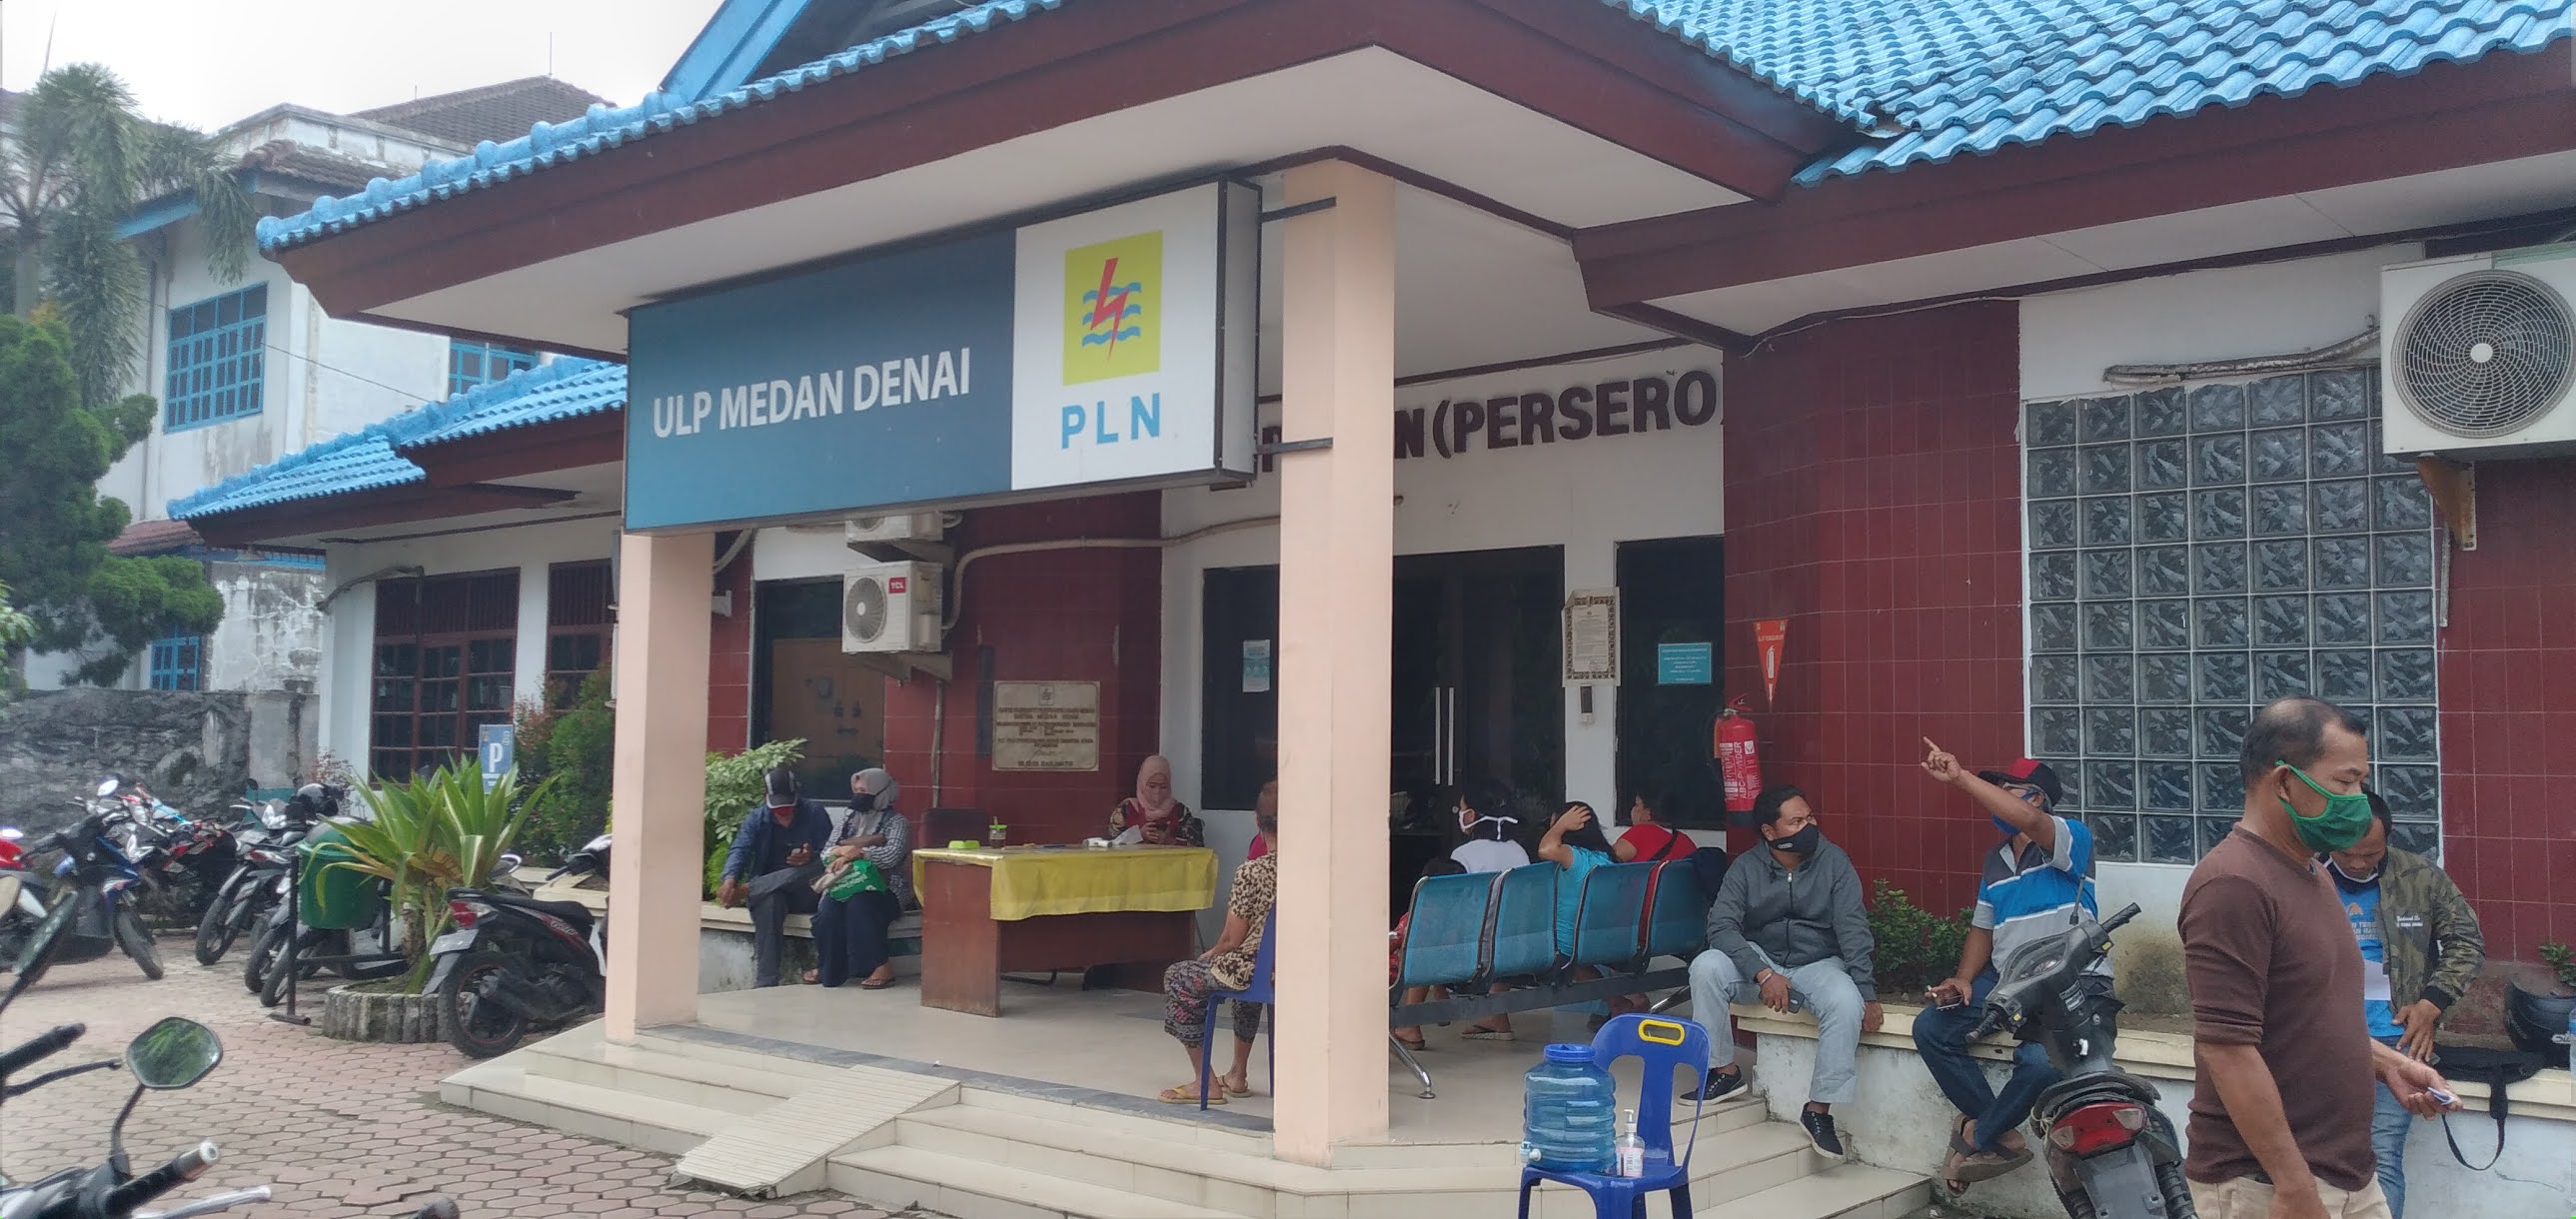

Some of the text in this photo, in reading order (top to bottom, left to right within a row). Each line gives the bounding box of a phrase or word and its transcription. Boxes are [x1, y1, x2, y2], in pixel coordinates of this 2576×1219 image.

[652, 347, 970, 438] ULP MEDAN DENAI
[1061, 393, 1161, 450] PLN
[1432, 370, 1723, 460] (PERSERO
[489, 742, 504, 773] P
